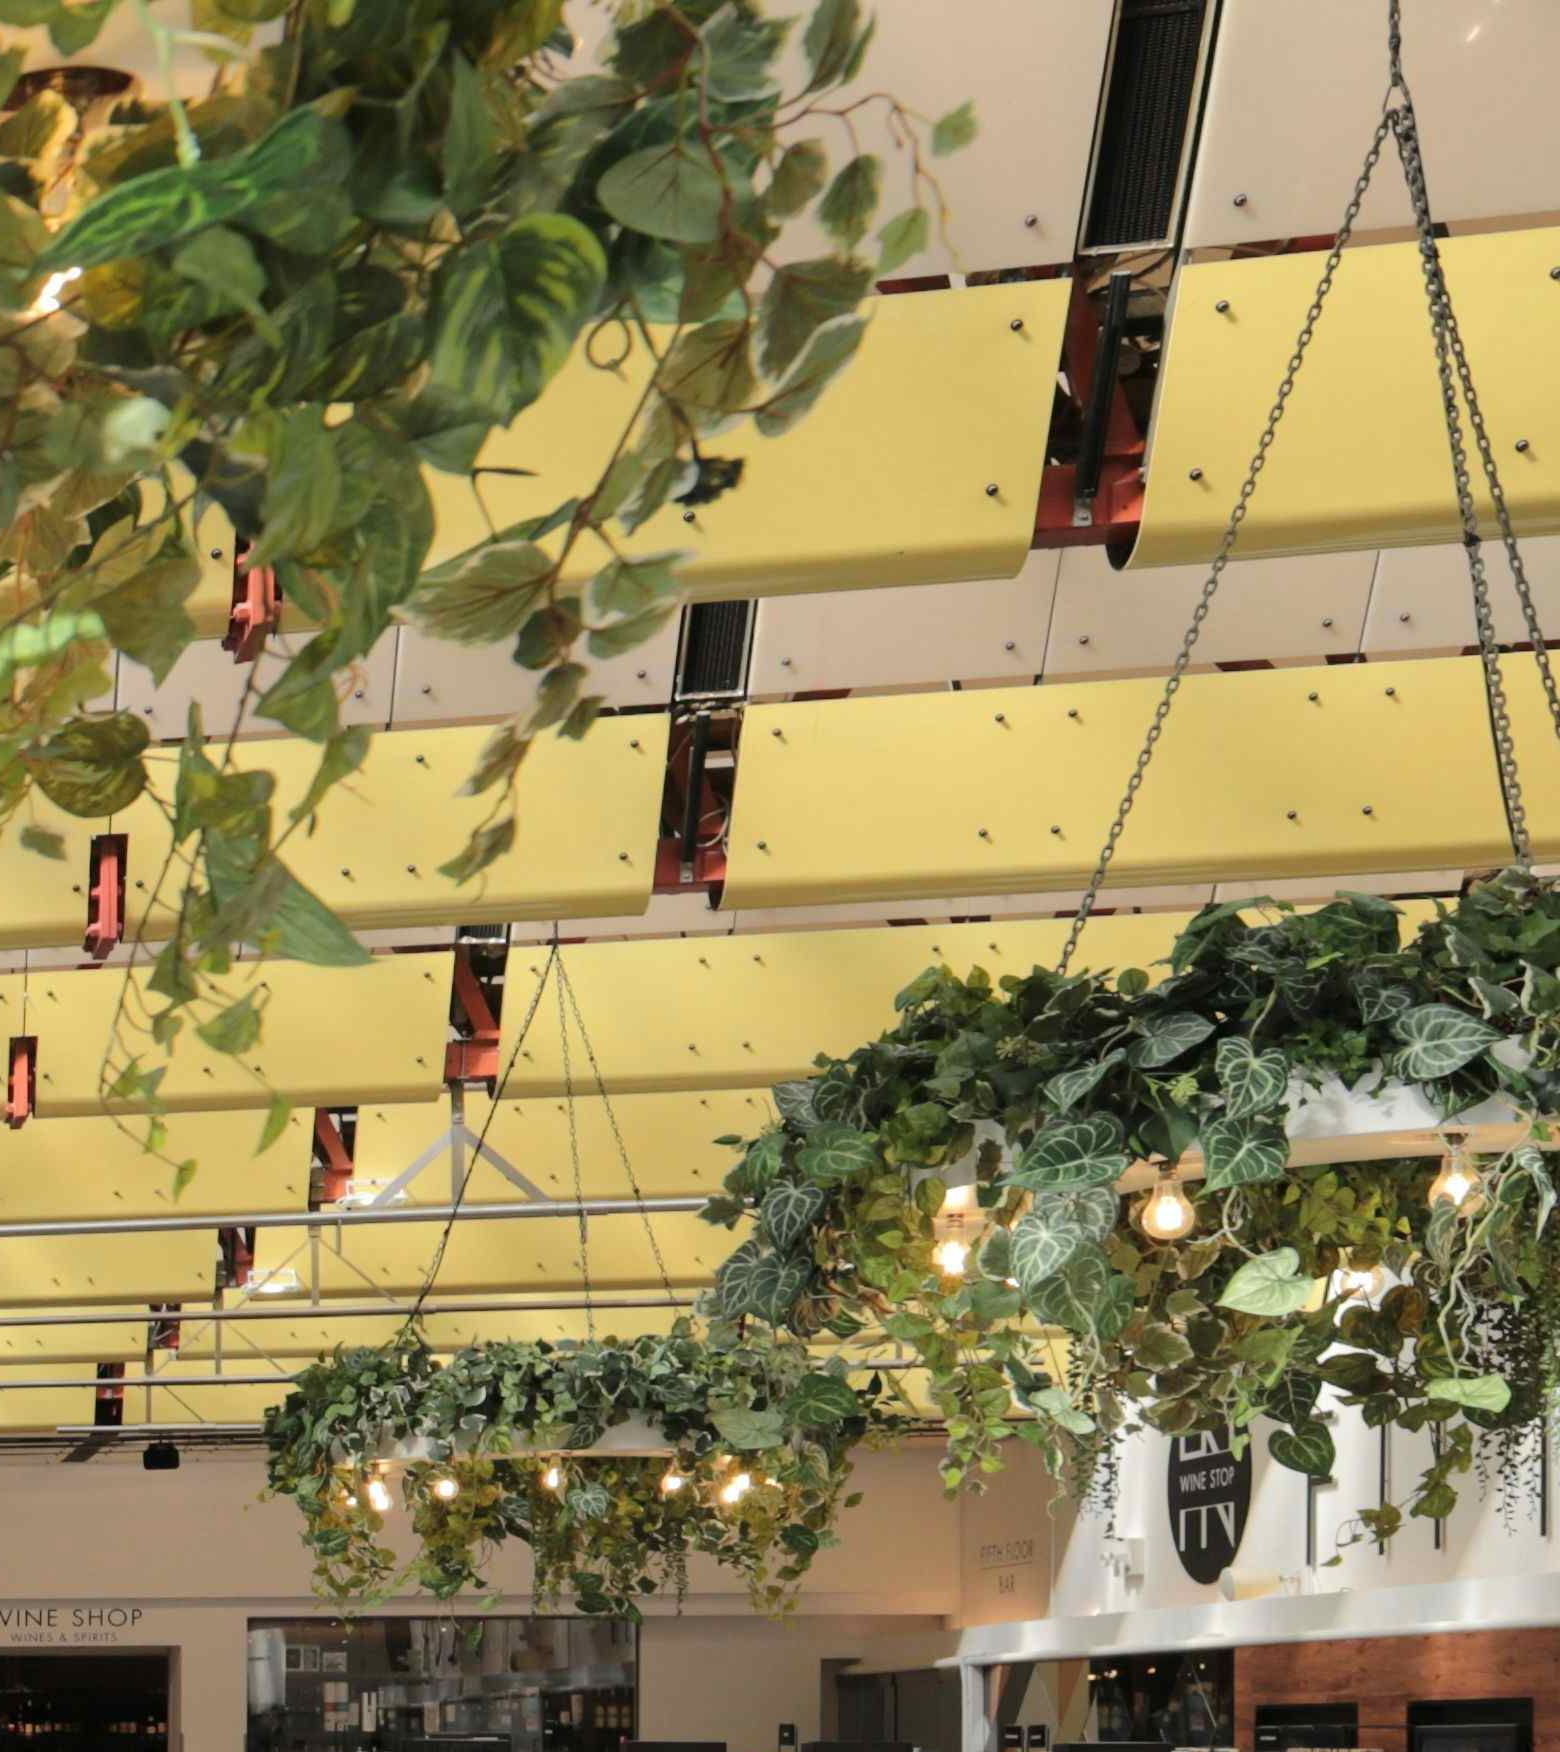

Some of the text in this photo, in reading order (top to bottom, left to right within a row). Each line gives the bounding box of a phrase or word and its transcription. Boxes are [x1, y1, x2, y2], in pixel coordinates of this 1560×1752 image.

[1179, 1465, 1235, 1493] WINE STOP
[71, 1608, 144, 1628] SHOP
[10, 1631, 119, 1643] WINES & SPIRITS
